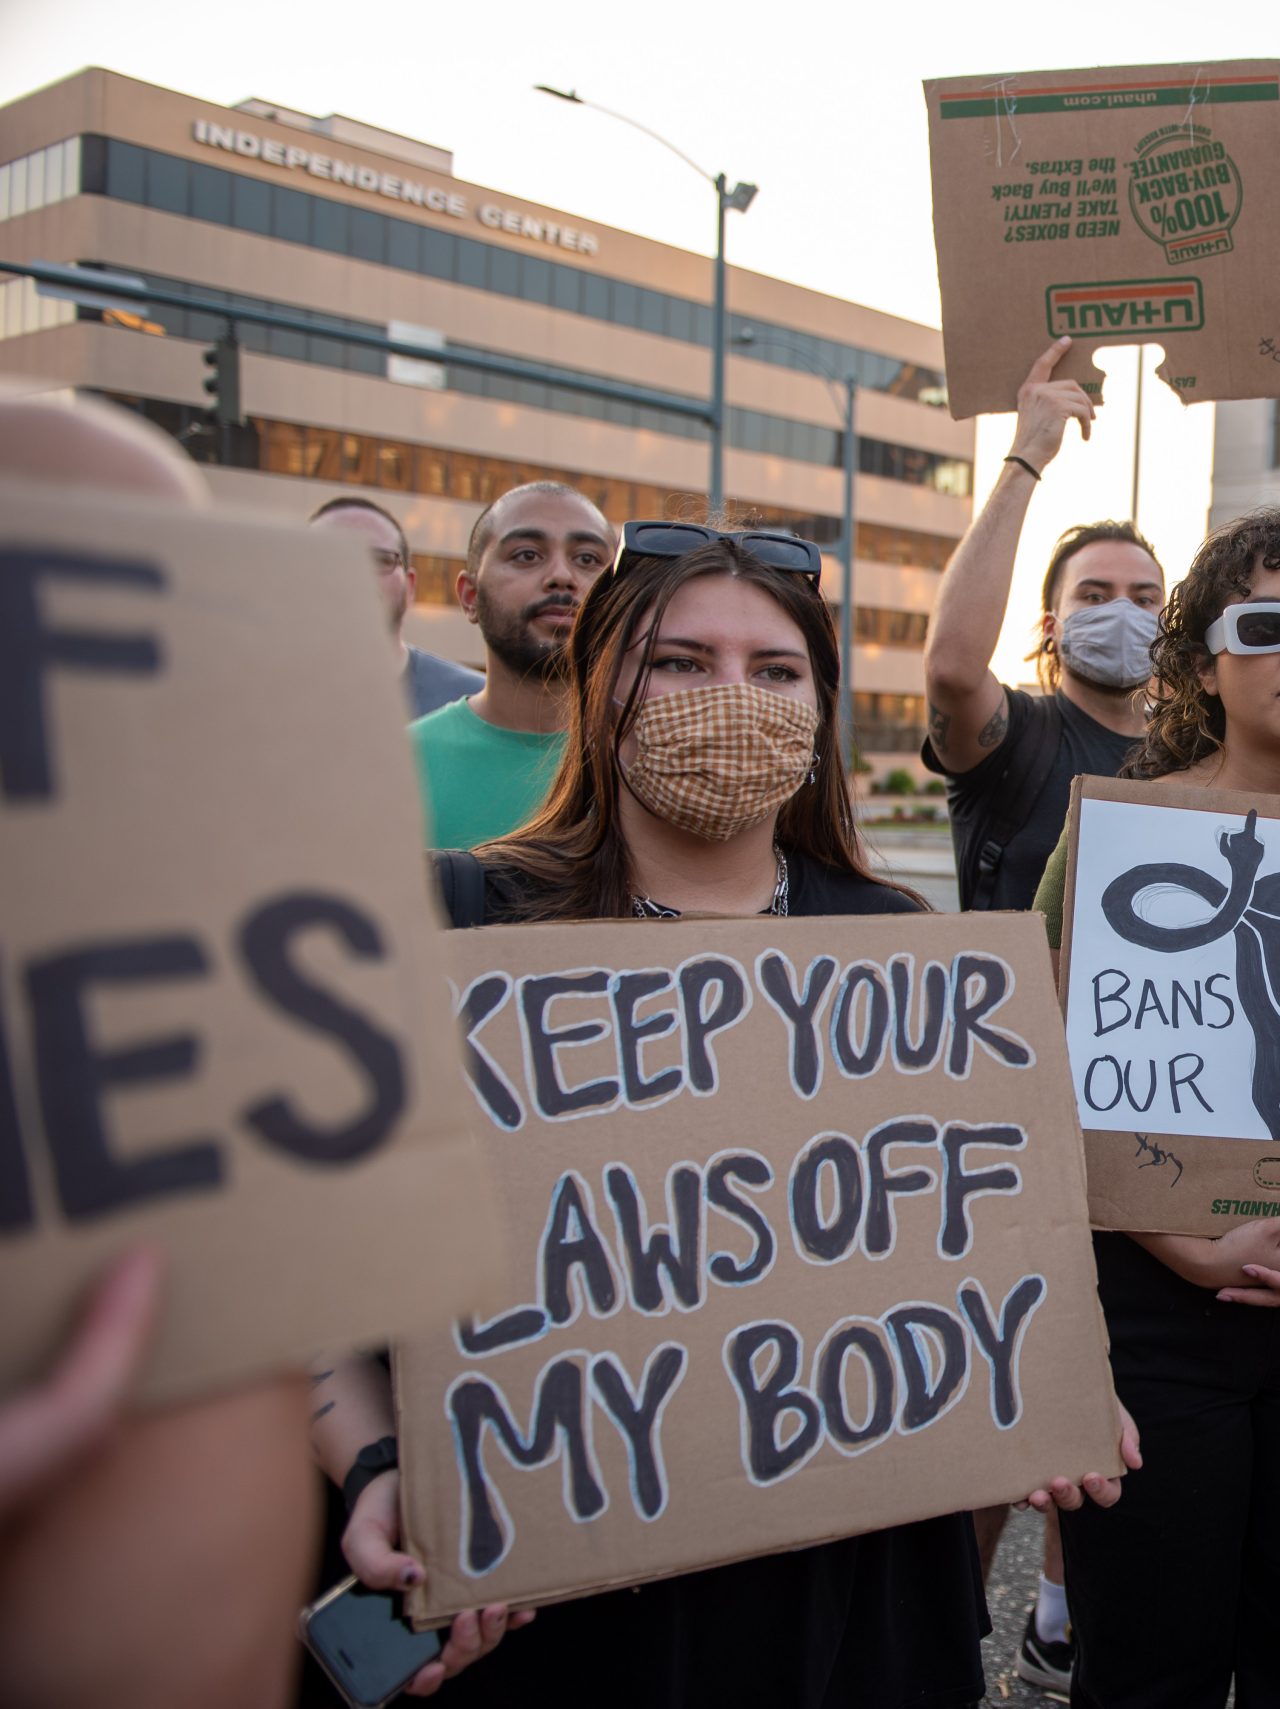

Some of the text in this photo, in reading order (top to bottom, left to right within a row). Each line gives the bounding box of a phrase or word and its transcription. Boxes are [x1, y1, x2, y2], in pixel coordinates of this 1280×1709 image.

[1063, 92, 1157, 107] uhaul.com
[195, 119, 599, 255] INDEPENDENCE CENTER
[992, 178, 1117, 201] We'll Buy Back
[1026, 157, 1115, 176] the Extras.
[1136, 163, 1231, 203] BUY-BACK
[1004, 199, 1118, 222] TAKE PLENTY!
[1004, 220, 1120, 243] NEED BOXES?
[1151, 191, 1230, 237] 100%
[756, 948, 1036, 1099] YOUR
[1091, 968, 1235, 1037] BANS
[1083, 1053, 1214, 1114] OUR
[789, 1115, 1028, 1264] OFF
[446, 1275, 1047, 1577] MY BODY
